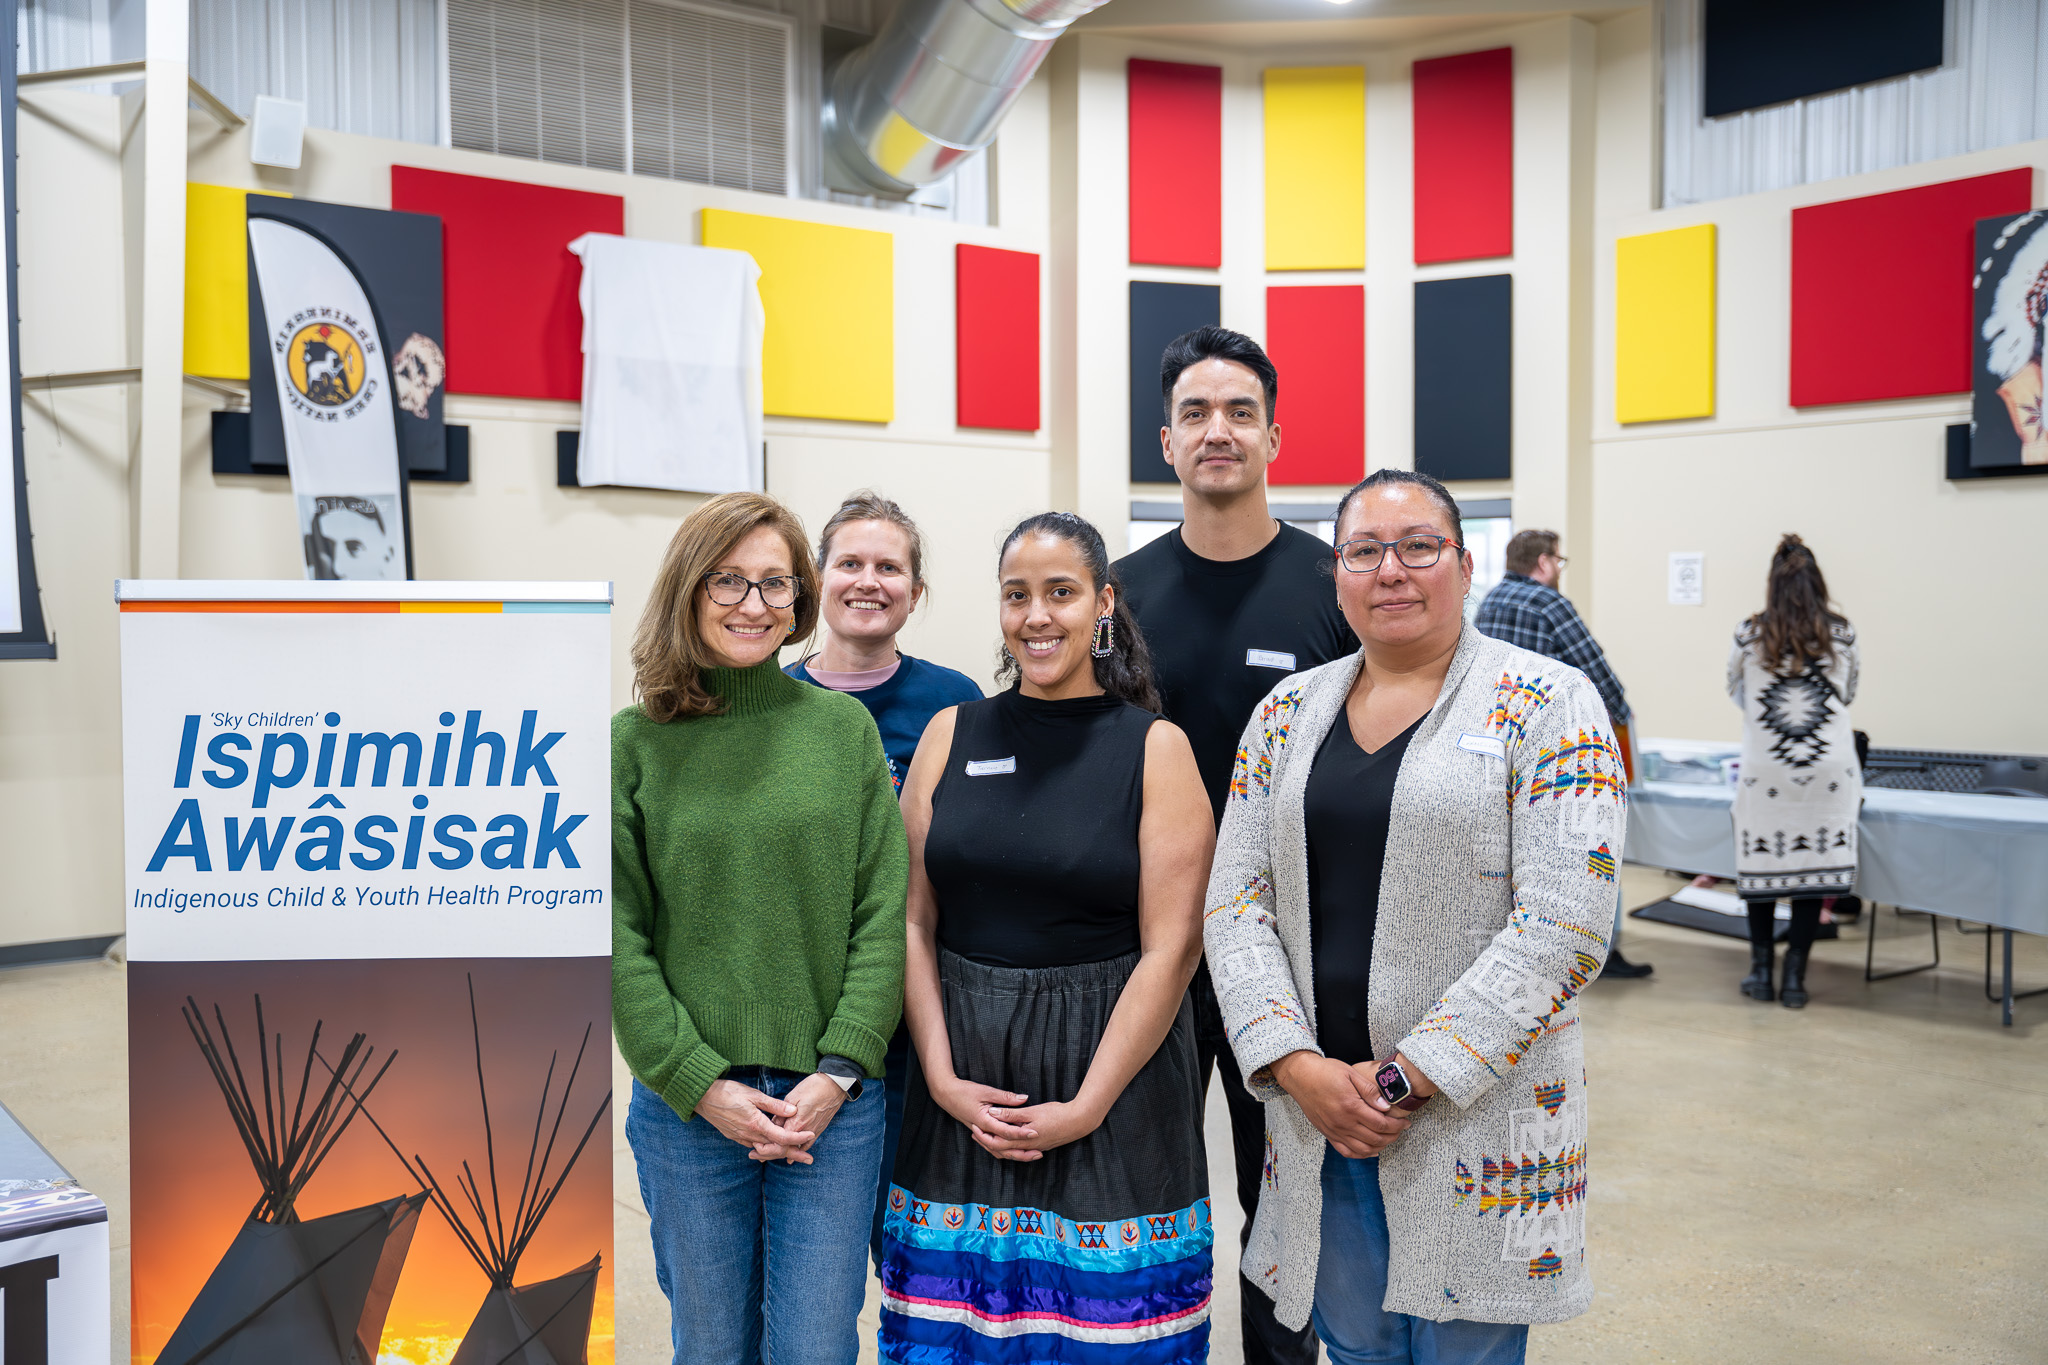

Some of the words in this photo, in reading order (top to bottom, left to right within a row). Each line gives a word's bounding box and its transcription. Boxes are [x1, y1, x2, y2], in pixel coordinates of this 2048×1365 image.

[173, 709, 567, 809] Ispimihk
[145, 793, 590, 873] Awâsisak
[134, 888, 259, 914] Indigenous
[267, 887, 325, 907] Child
[331, 886, 347, 907] &
[355, 886, 420, 907] Youth
[428, 885, 500, 906] Health
[508, 885, 604, 910] Program
